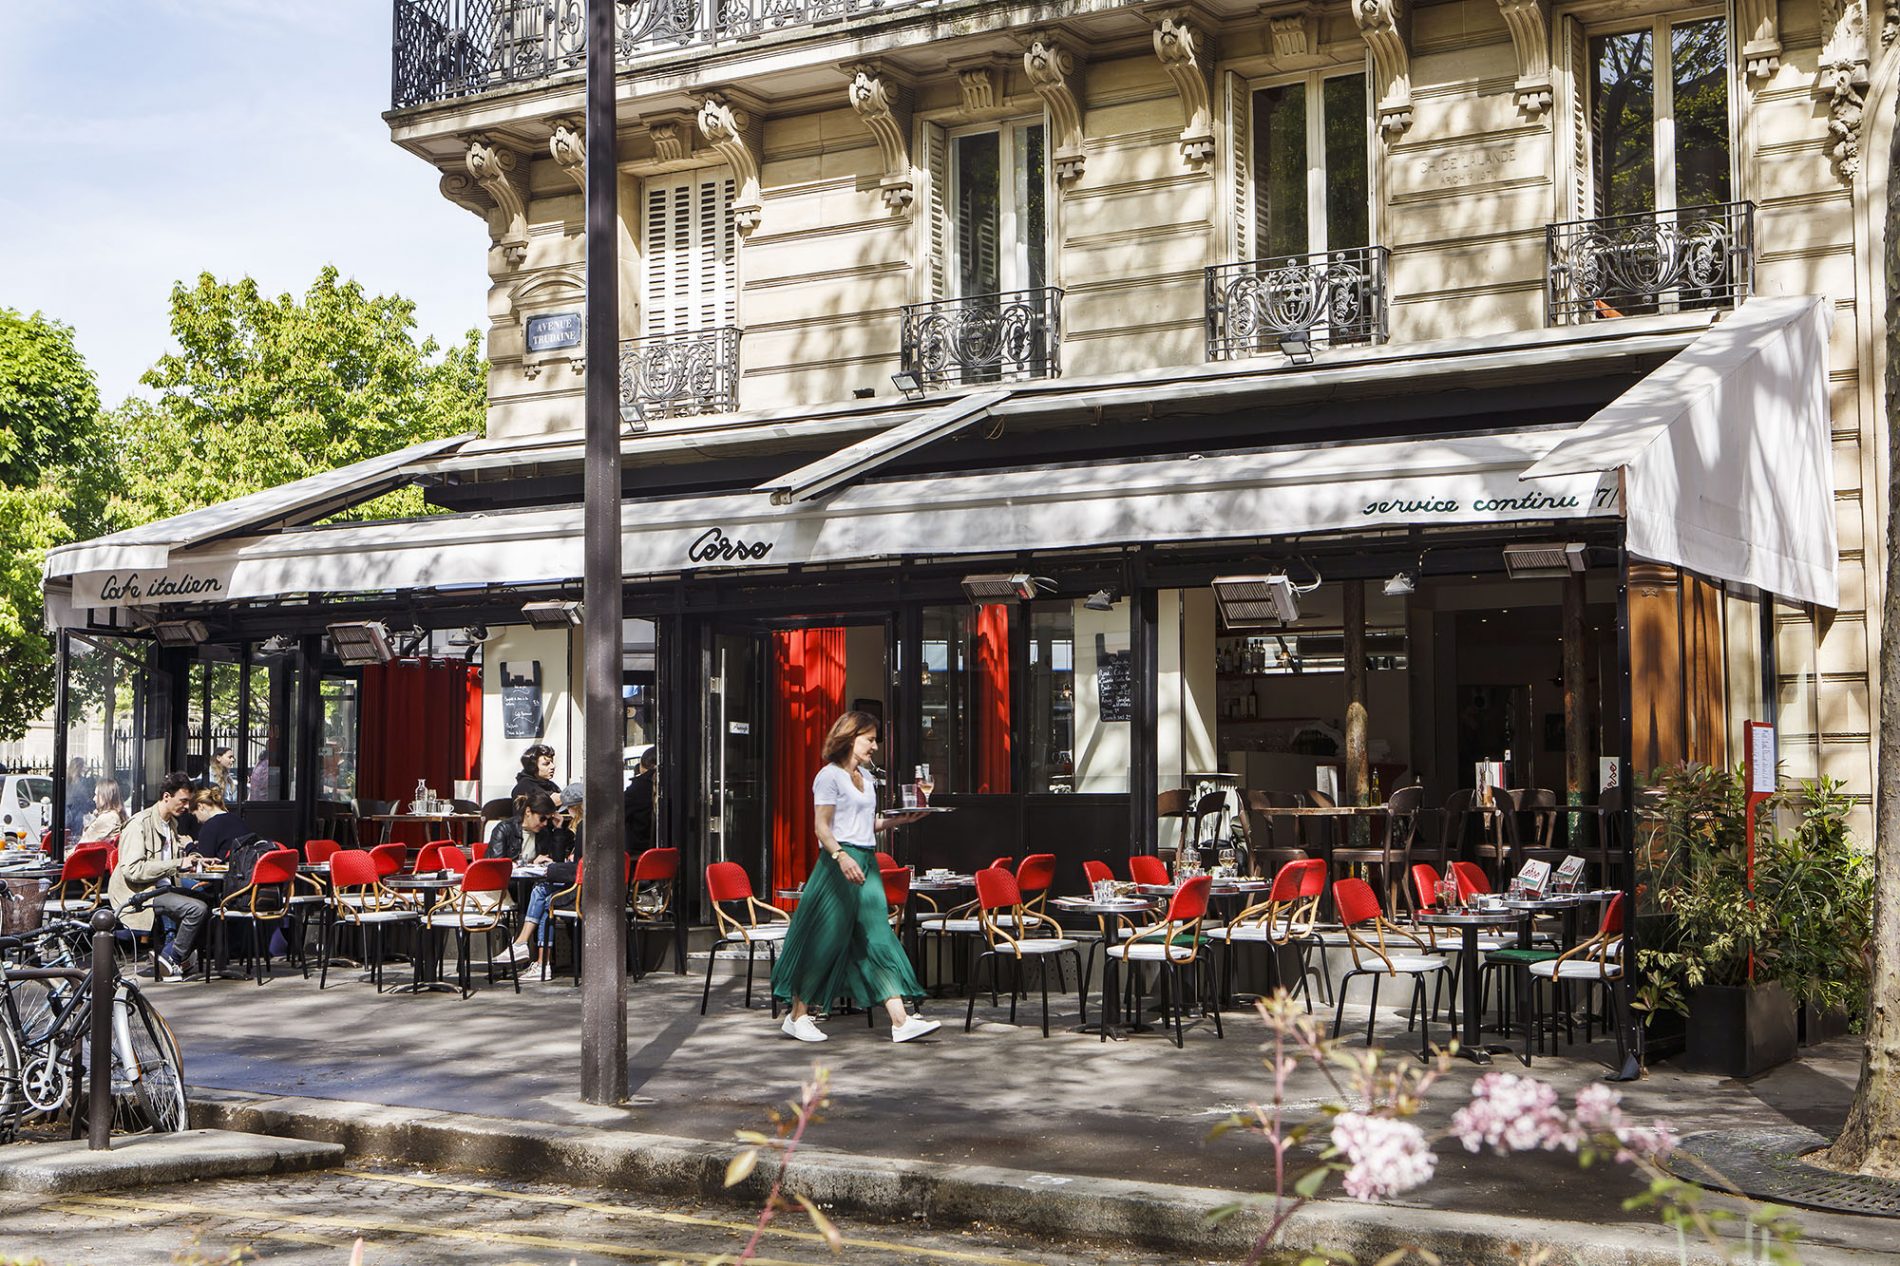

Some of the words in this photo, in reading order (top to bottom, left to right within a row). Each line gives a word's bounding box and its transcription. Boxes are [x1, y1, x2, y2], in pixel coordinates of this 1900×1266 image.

[536, 318, 573, 333] AVENUE
[533, 331, 576, 345] TRUDAINE
[1363, 495, 1459, 515] service
[1473, 491, 1579, 511] continu
[688, 527, 773, 563] Corso
[146, 573, 222, 597] italien
